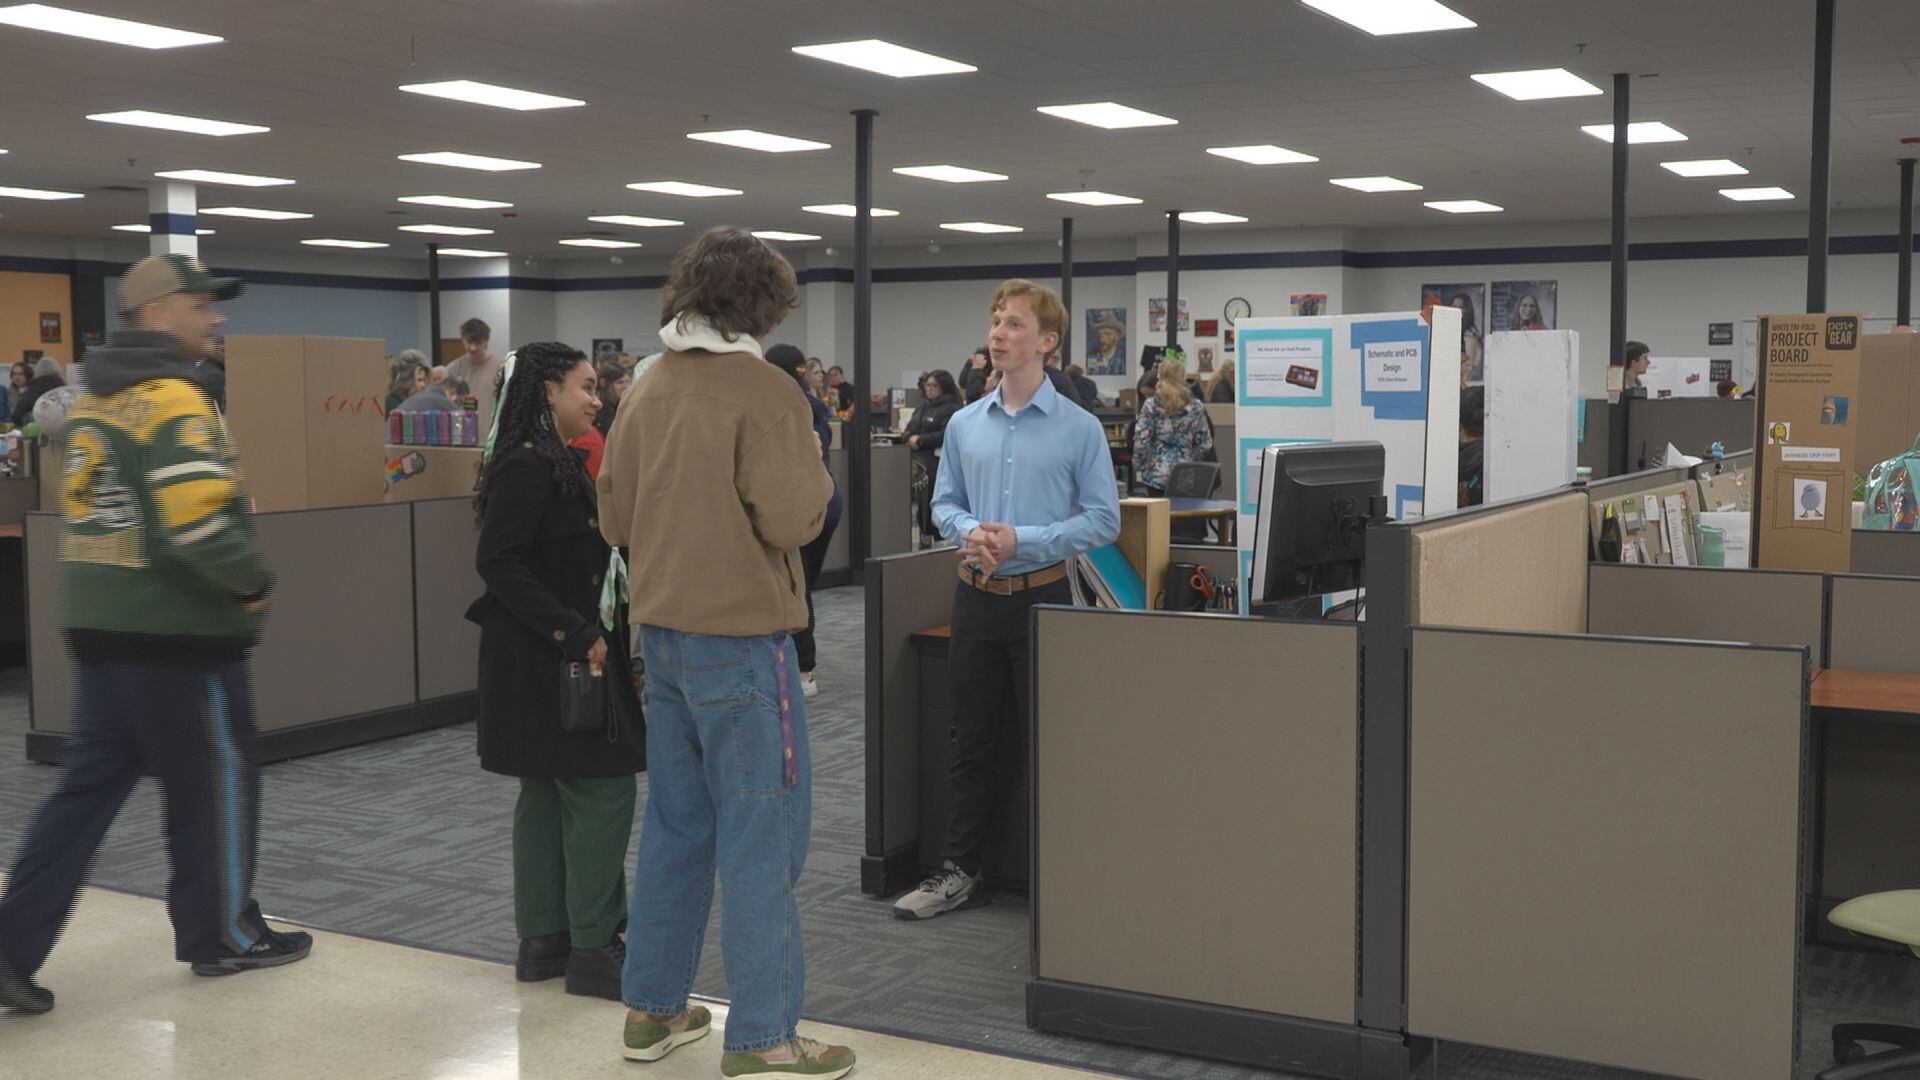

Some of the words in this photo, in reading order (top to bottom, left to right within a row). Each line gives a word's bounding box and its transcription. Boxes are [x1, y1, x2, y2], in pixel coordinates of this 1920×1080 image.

[1771, 332, 1819, 347] PROJECT
[1830, 331, 1853, 345] GEAR
[1368, 349, 1394, 358] Schematic
[1395, 349, 1405, 357] and
[1406, 348, 1417, 357] PCB
[1770, 348, 1809, 363] BOARD
[1383, 363, 1402, 373] Design
